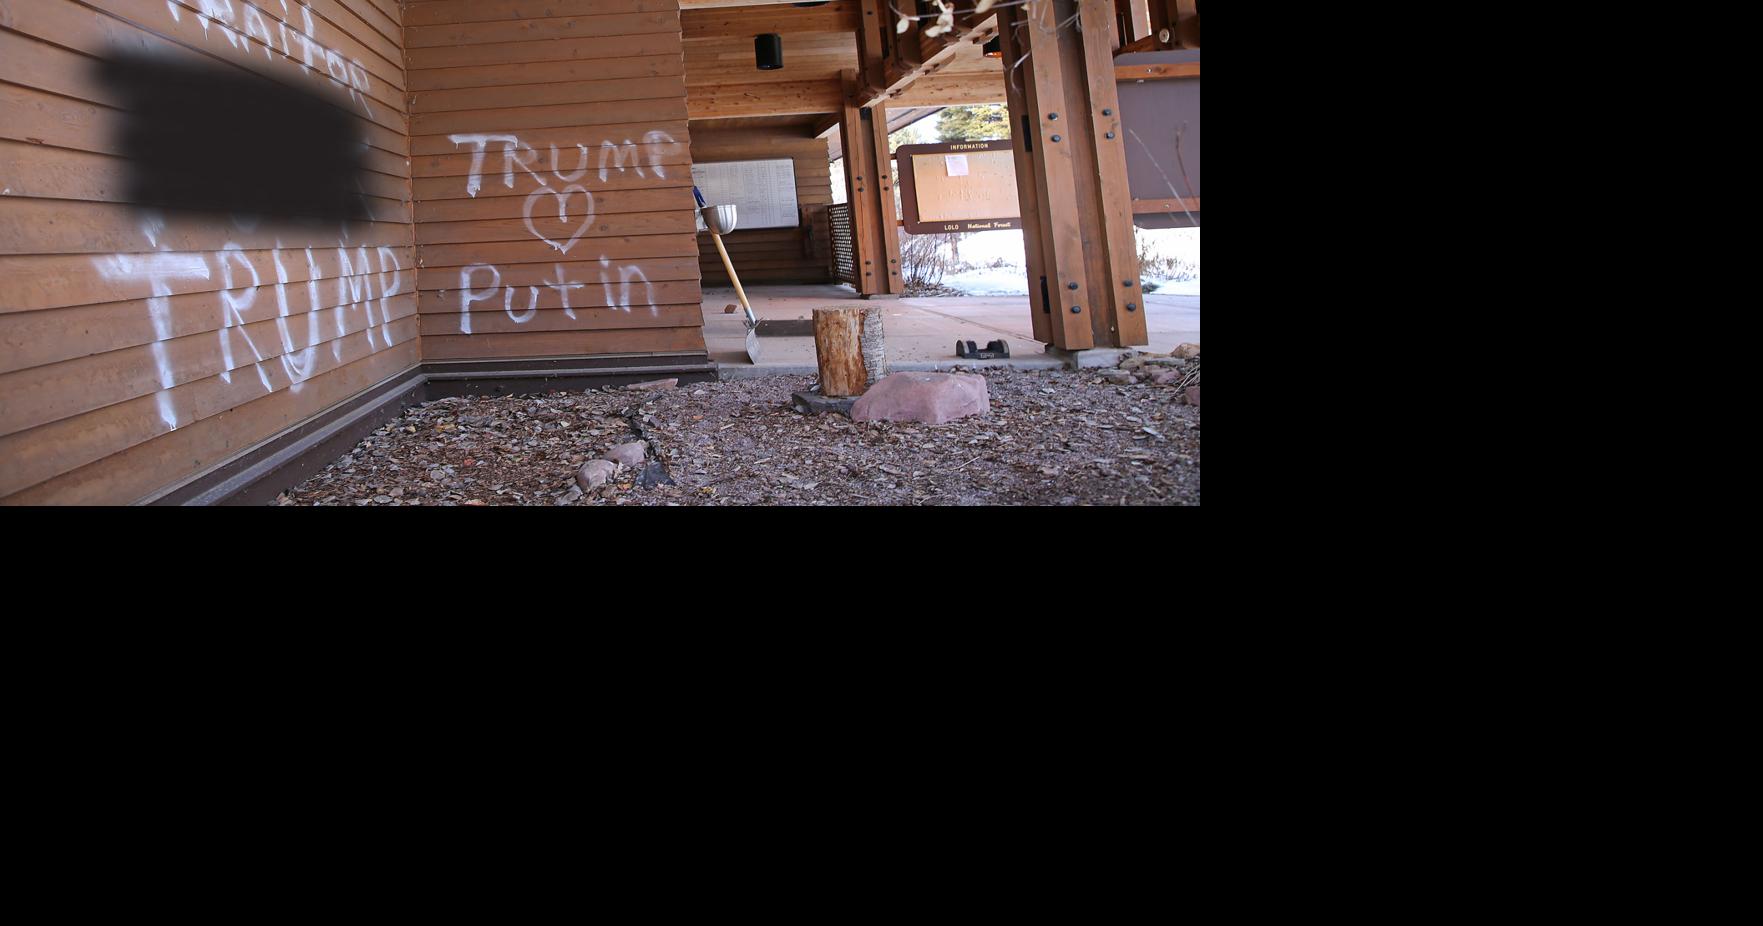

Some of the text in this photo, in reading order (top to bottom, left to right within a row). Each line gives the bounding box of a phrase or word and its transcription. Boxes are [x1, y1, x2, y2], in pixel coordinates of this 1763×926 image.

[448, 131, 681, 198] TRUMP
[967, 222, 991, 230] National
[460, 254, 657, 334] Putin
[93, 241, 400, 431] TRUMP
